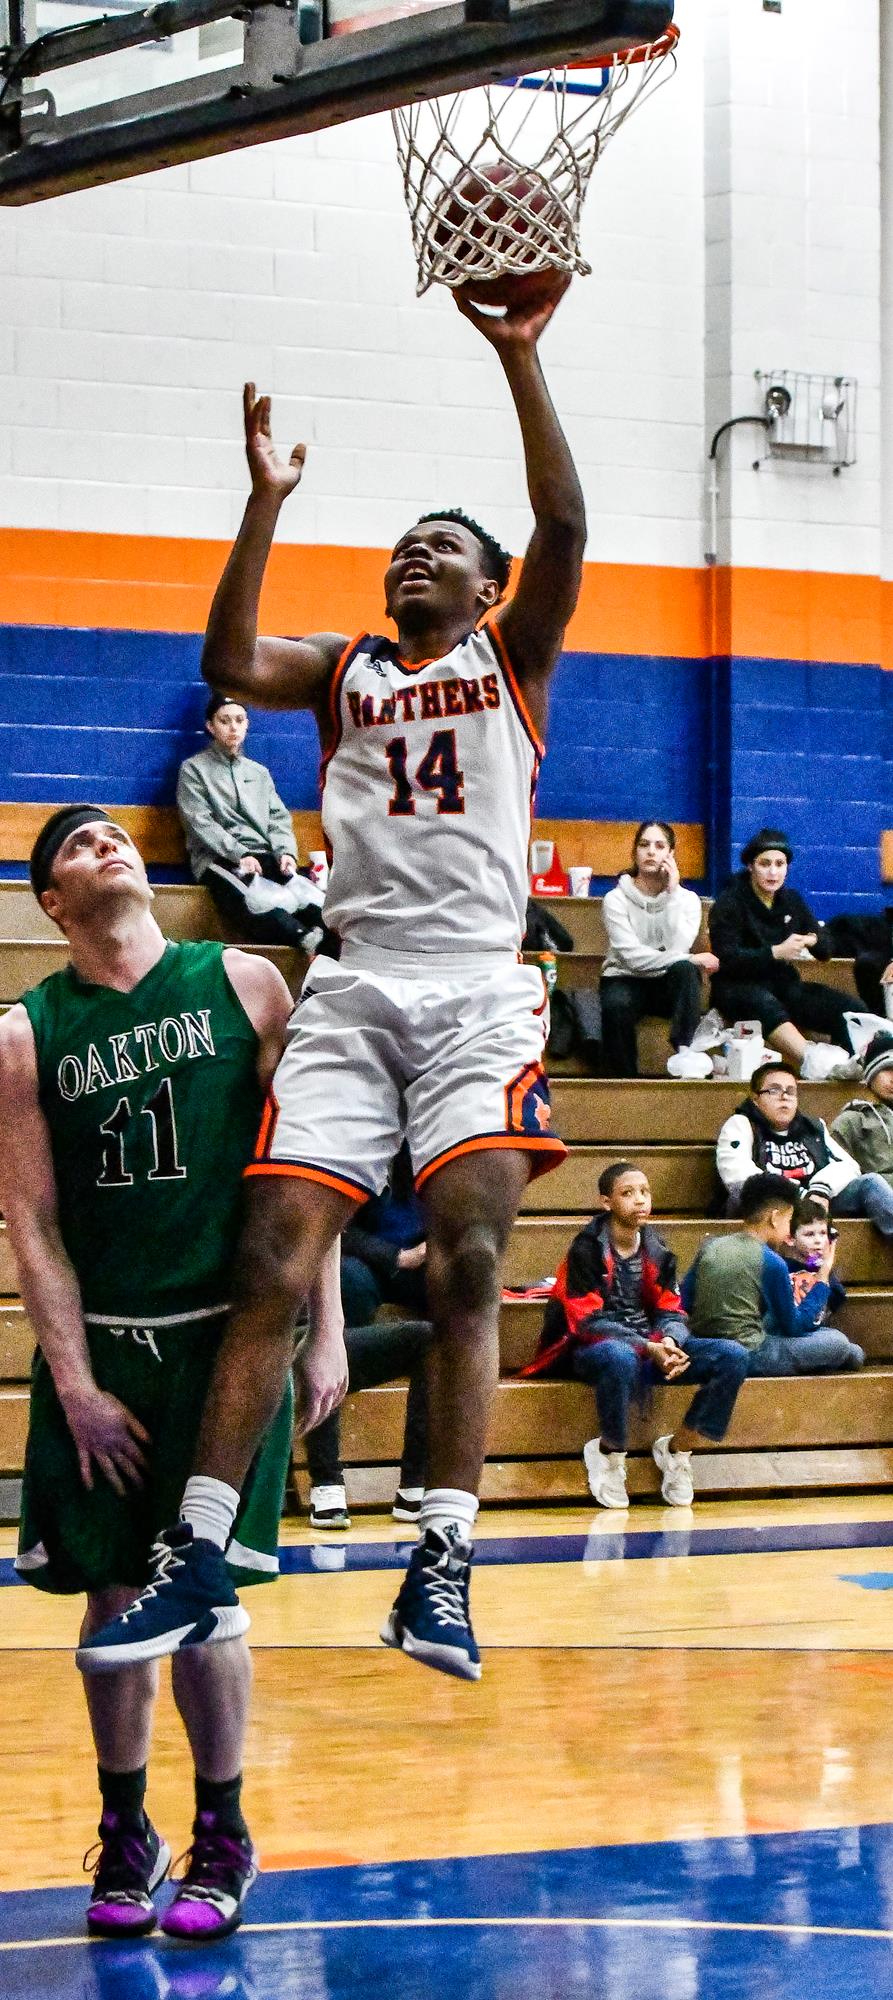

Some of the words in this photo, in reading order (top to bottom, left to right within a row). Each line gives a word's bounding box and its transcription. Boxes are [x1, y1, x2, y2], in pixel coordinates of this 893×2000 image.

[385, 728, 465, 816] 14
[58, 1009, 216, 1101] OAKTON
[96, 1077, 187, 1187] 11
